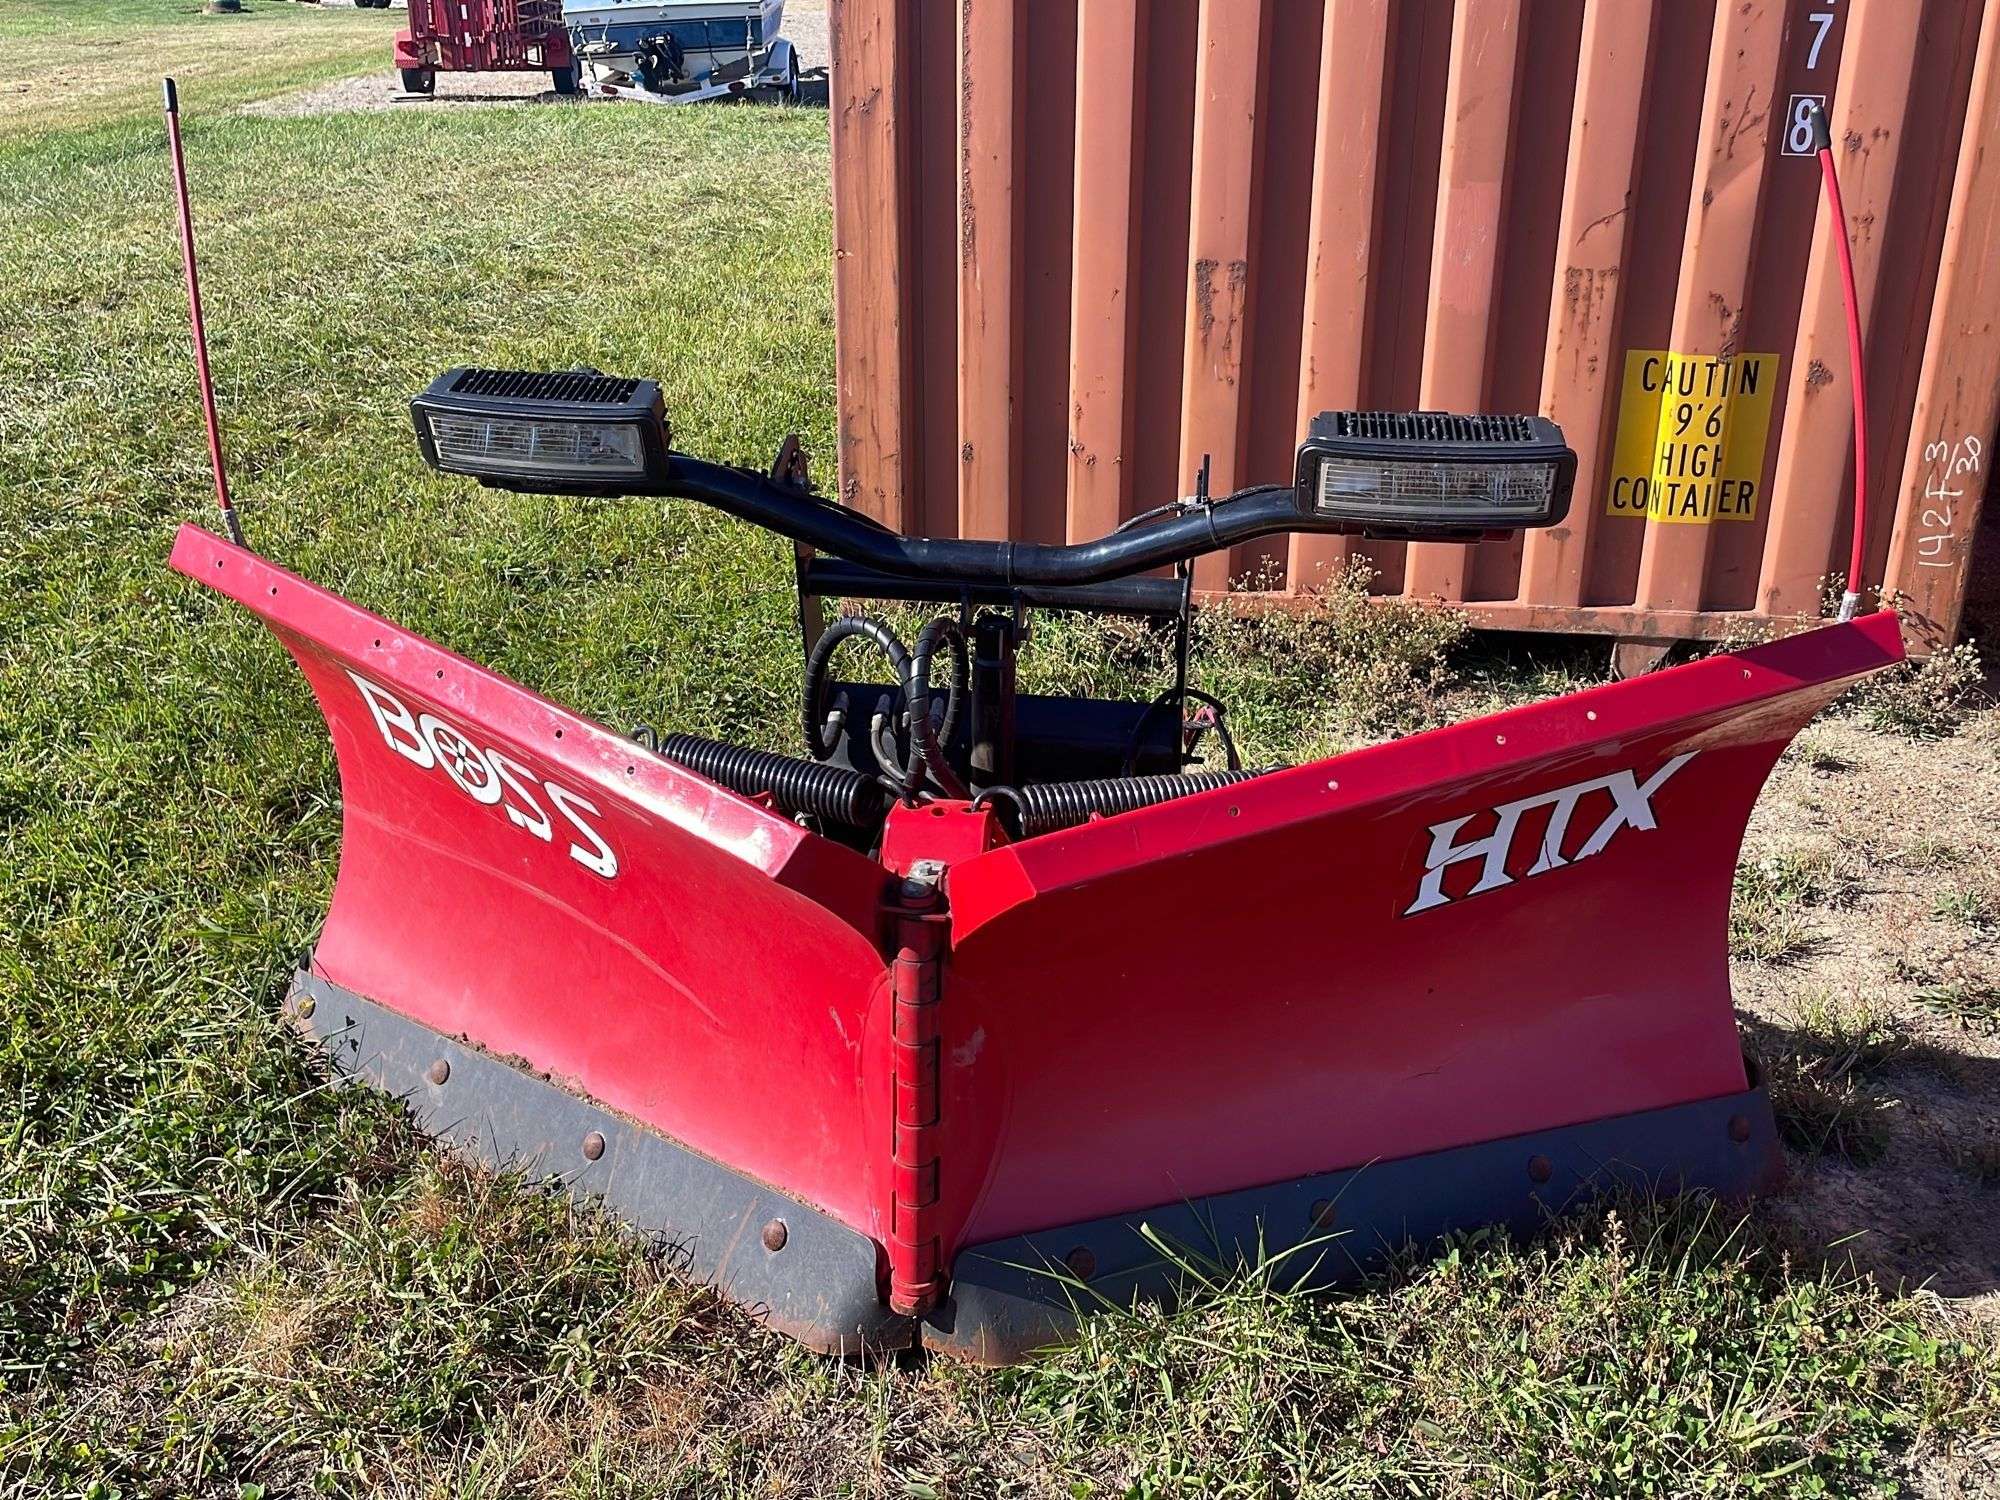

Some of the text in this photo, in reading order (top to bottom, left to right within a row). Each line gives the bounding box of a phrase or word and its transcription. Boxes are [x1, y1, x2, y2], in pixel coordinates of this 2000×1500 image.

[1807, 0, 1835, 69] 7
[1642, 357, 1760, 398] CAUTIN
[1675, 403, 1723, 437] 9'6
[1612, 476, 1755, 517] CONTAIER
[345, 669, 618, 879] BOSS
[1402, 750, 1701, 916] HTX
